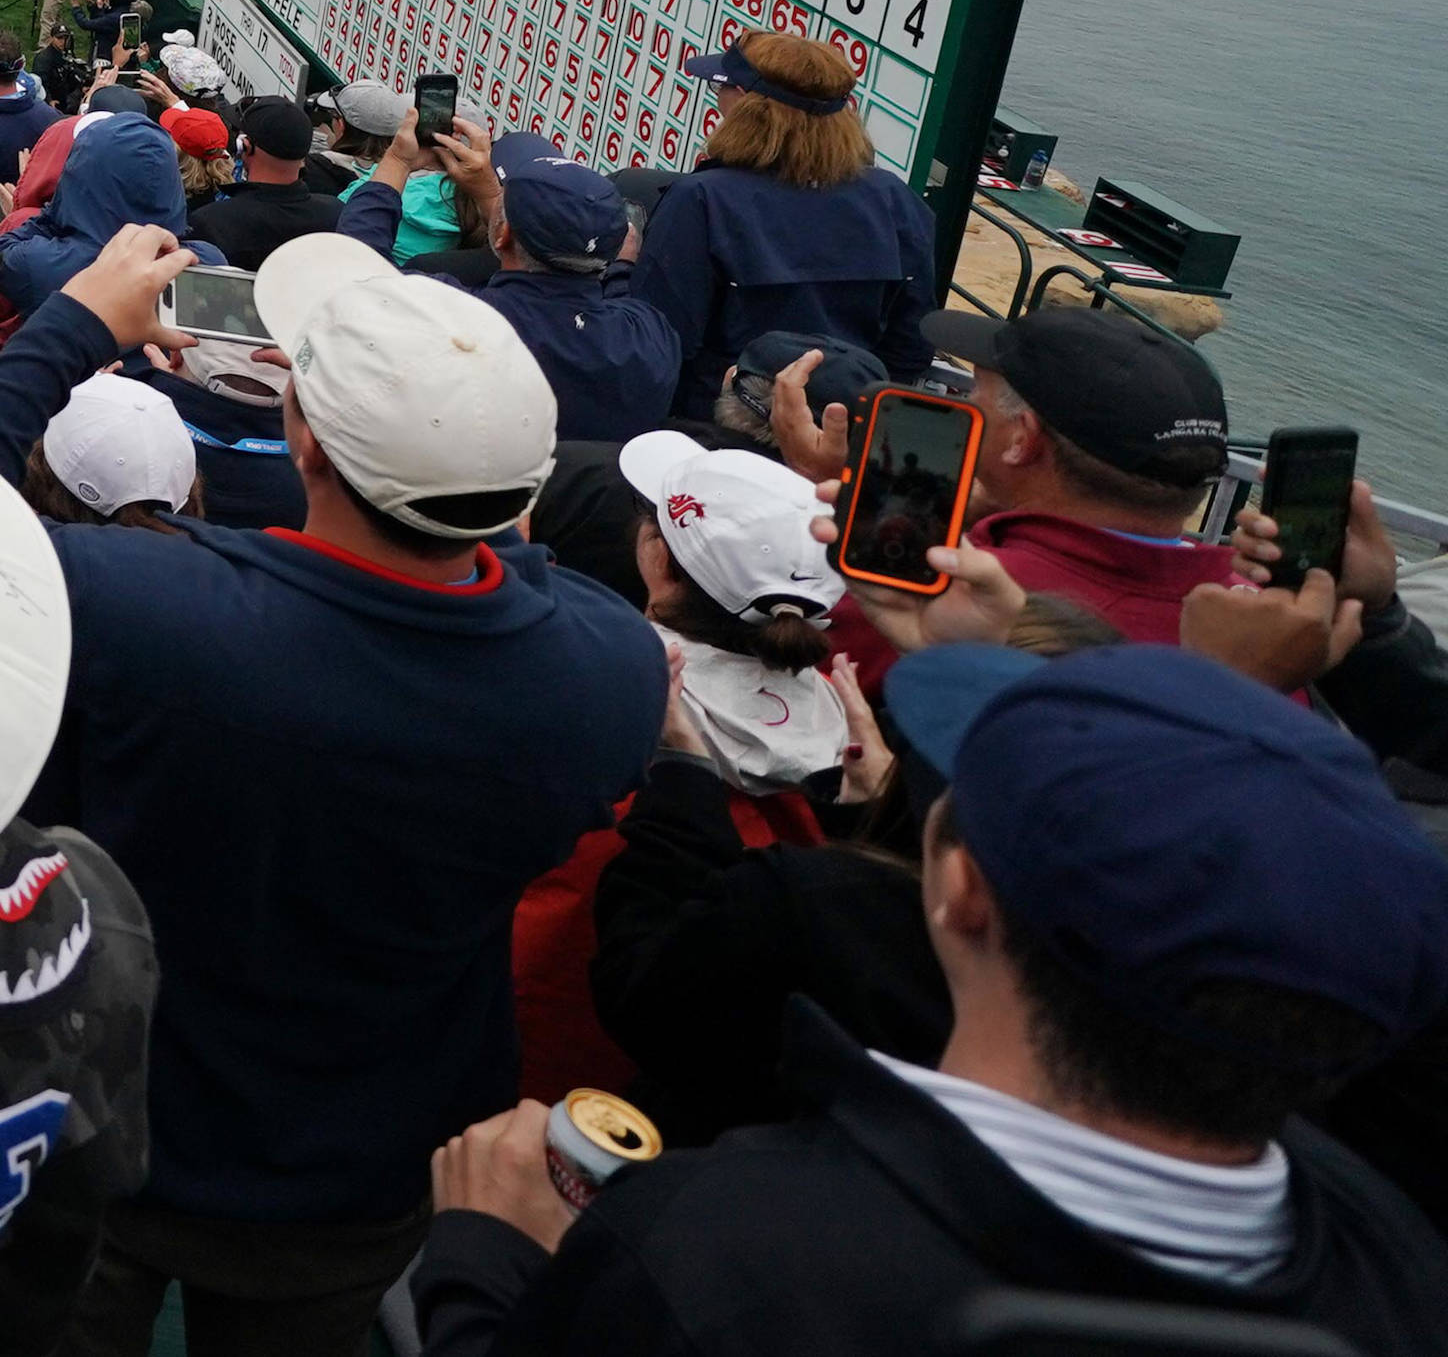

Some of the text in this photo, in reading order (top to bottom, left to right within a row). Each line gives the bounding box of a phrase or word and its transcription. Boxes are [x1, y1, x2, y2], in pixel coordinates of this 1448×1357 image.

[206, 6, 237, 55] 3 ROSE
[257, 29, 268, 54] 17
[280, 53, 295, 85] TOTAL
[553, 0, 566, 28] 7
[575, 14, 588, 43] 7
[596, 29, 610, 59] 7
[623, 47, 637, 78] 7
[647, 65, 664, 96] 7
[673, 84, 689, 116] 7
